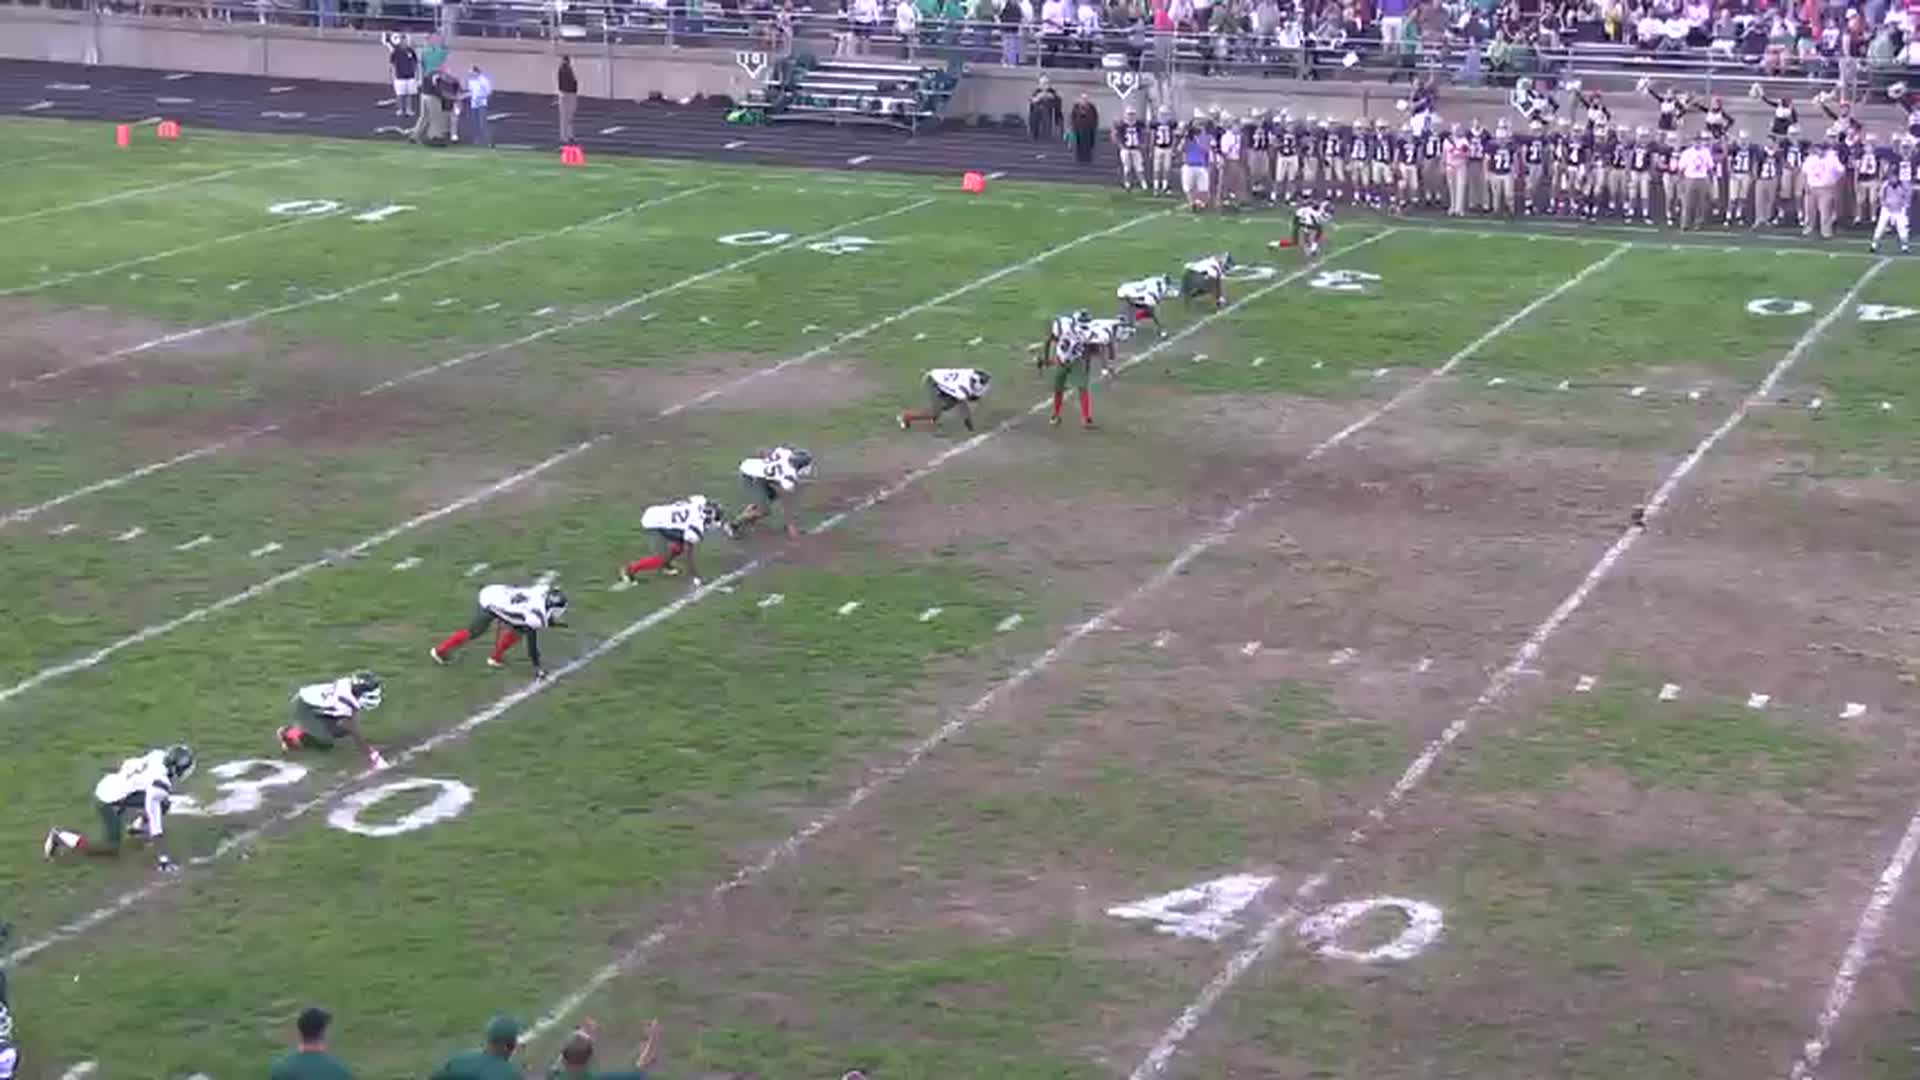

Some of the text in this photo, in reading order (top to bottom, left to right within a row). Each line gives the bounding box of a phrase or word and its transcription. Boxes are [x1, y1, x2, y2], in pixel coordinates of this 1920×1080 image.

[744, 53, 760, 65] 10
[1112, 72, 1133, 85] 20
[165, 759, 475, 837] 30
[1106, 874, 1443, 962] 40
